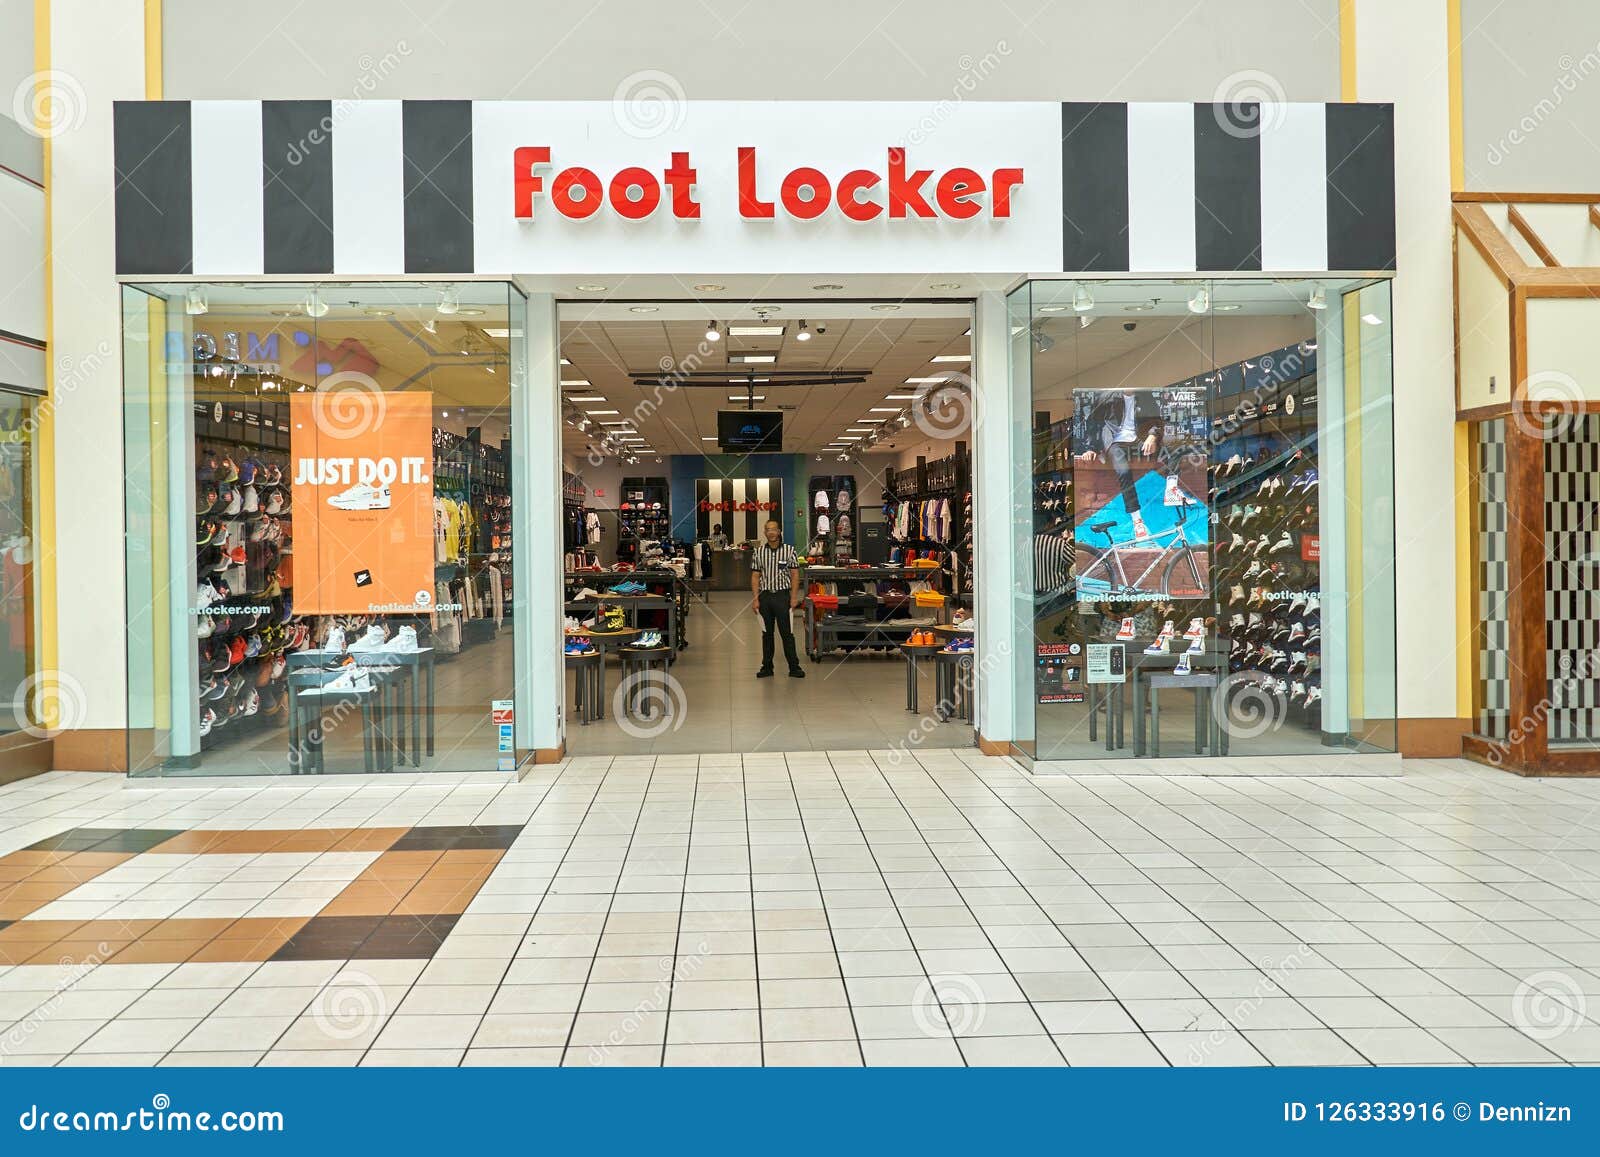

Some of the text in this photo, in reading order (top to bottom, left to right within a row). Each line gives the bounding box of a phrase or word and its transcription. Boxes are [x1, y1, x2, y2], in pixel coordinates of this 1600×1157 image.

[513, 146, 1025, 223] Foot Locker
[1172, 391, 1197, 401] VANS
[294, 457, 430, 485] JUST DO IT.
